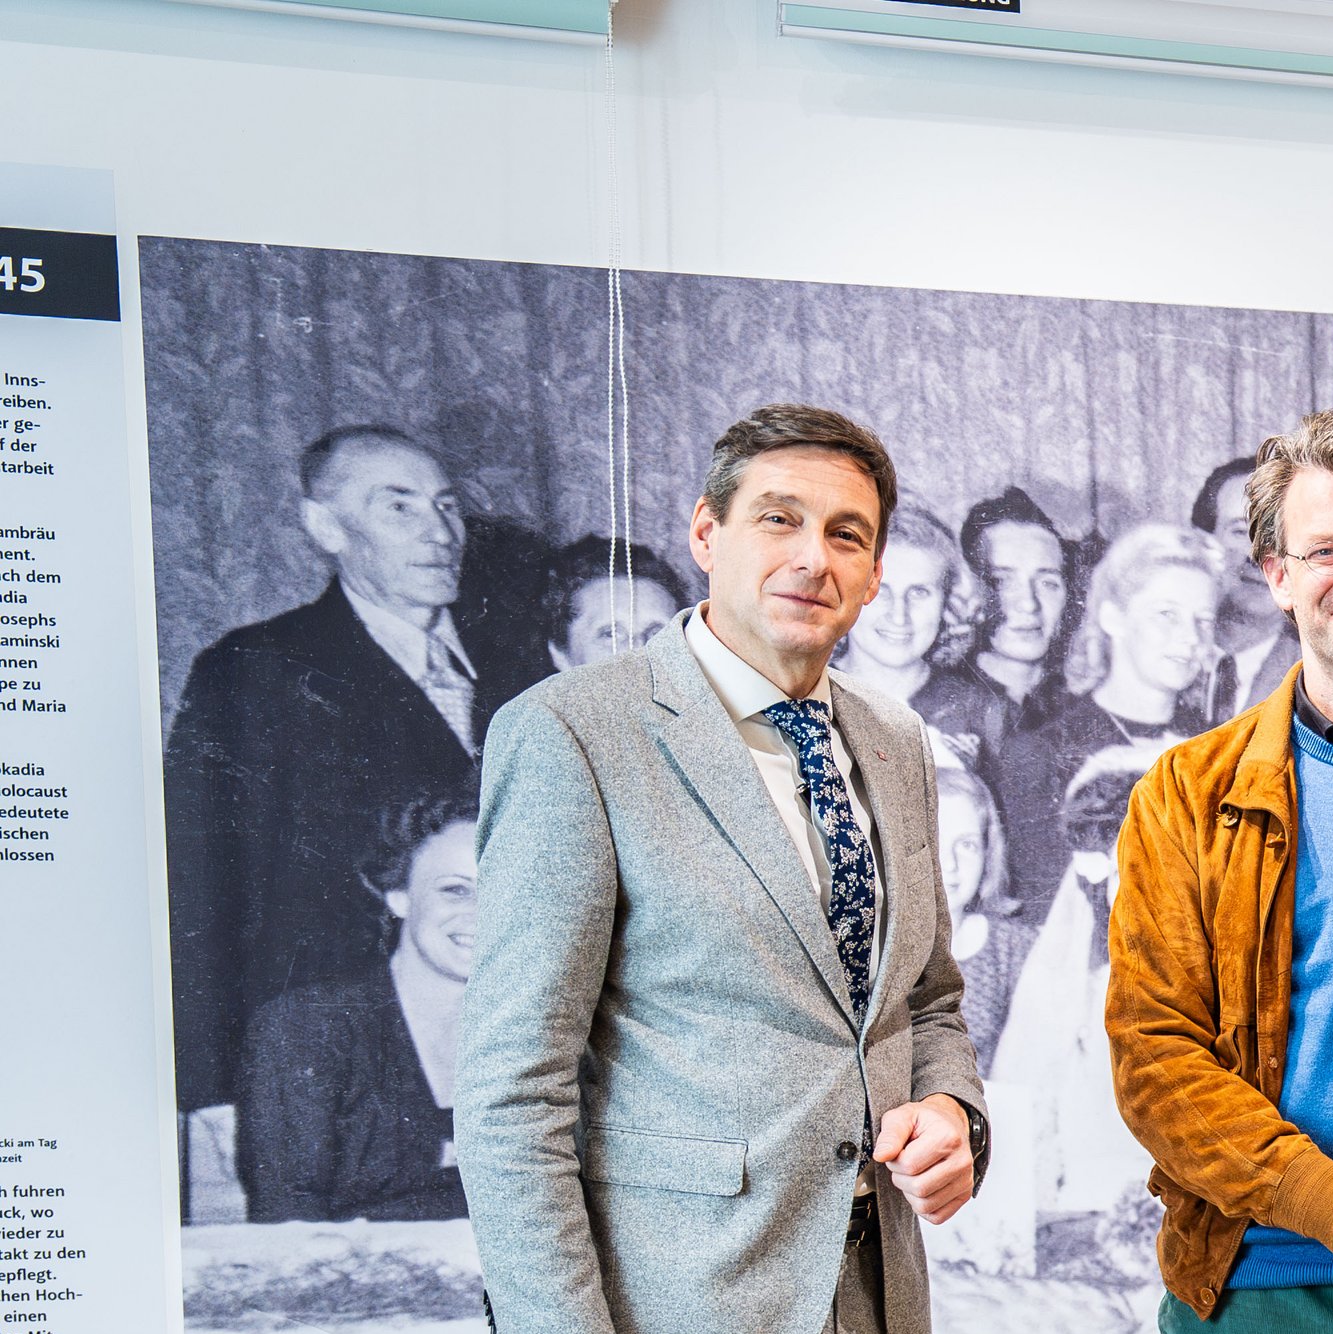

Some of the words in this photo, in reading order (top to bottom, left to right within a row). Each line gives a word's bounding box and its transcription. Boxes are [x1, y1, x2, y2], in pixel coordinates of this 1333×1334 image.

[0, 256, 46, 293] 45
[4, 372, 47, 388] Inns-
[0, 393, 52, 411] eiben.
[13, 419, 41, 435] ge-
[9, 437, 38, 453] der
[0, 568, 21, 583] ch
[25, 569, 62, 584] dem
[0, 589, 28, 605] dia
[22, 680, 42, 691] zu
[21, 698, 67, 713] Maria
[0, 761, 46, 777] kadia
[17, 1139, 36, 1149] am
[38, 1137, 58, 1150] Tag
[0, 1153, 23, 1164] zeit
[12, 1184, 65, 1198] fuhren
[0, 1205, 26, 1221] ck,
[29, 1208, 55, 1219] wo
[0, 1226, 42, 1240] ieder
[46, 1229, 65, 1239] zu
[33, 1250, 52, 1260] zu
[56, 1246, 87, 1260] den
[35, 1287, 83, 1302] Hoch-
[3, 1309, 48, 1324] einen
